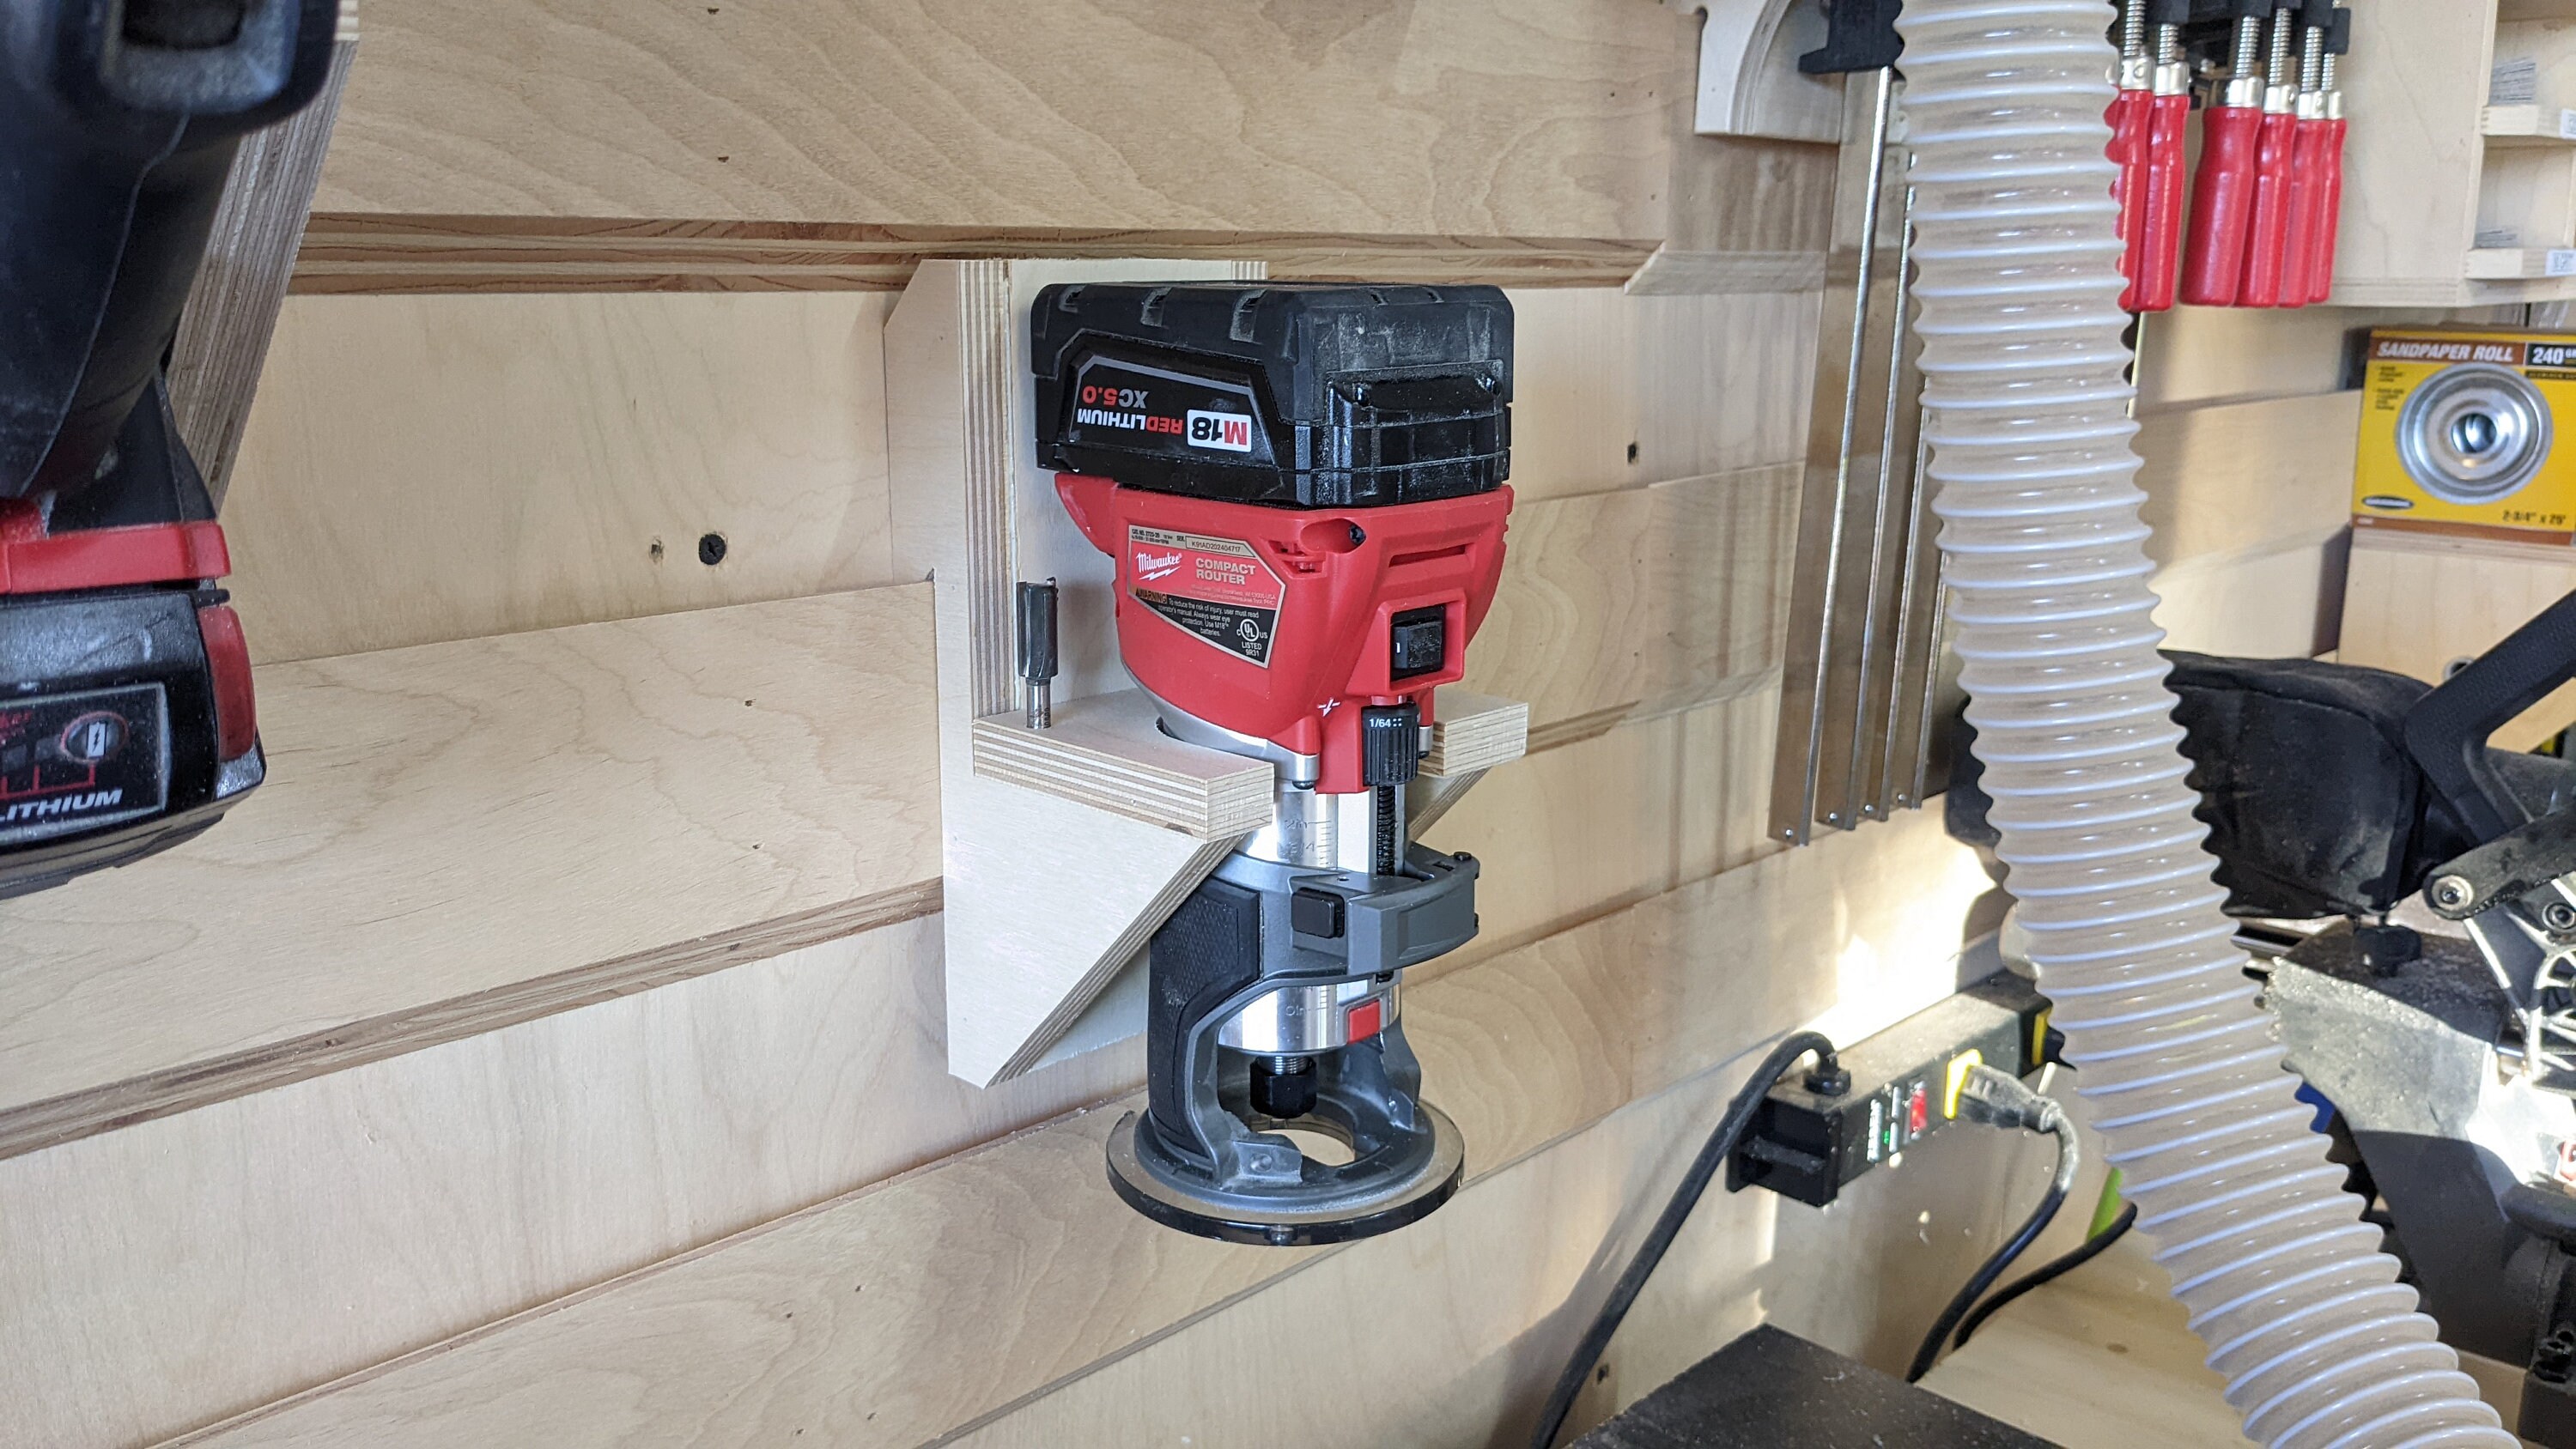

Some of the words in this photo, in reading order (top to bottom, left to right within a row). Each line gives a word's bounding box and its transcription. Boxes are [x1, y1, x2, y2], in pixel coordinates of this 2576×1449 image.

[2377, 343, 2469, 360] SANDPAPER
[2473, 346, 2514, 361] ROLL
[2532, 347, 2563, 364] 240
[1082, 385, 1150, 409] XC5.0
[1077, 408, 1184, 434] REDLITHIUM
[1191, 416, 1248, 446] M18
[1136, 552, 1181, 573] Milwaukee
[1195, 558, 1255, 574] COMPACT
[1196, 568, 1246, 585] ROUTER
[1139, 589, 1167, 603] WARNING
[1242, 641, 1261, 650] LISTED
[1369, 718, 1391, 728] 1/64
